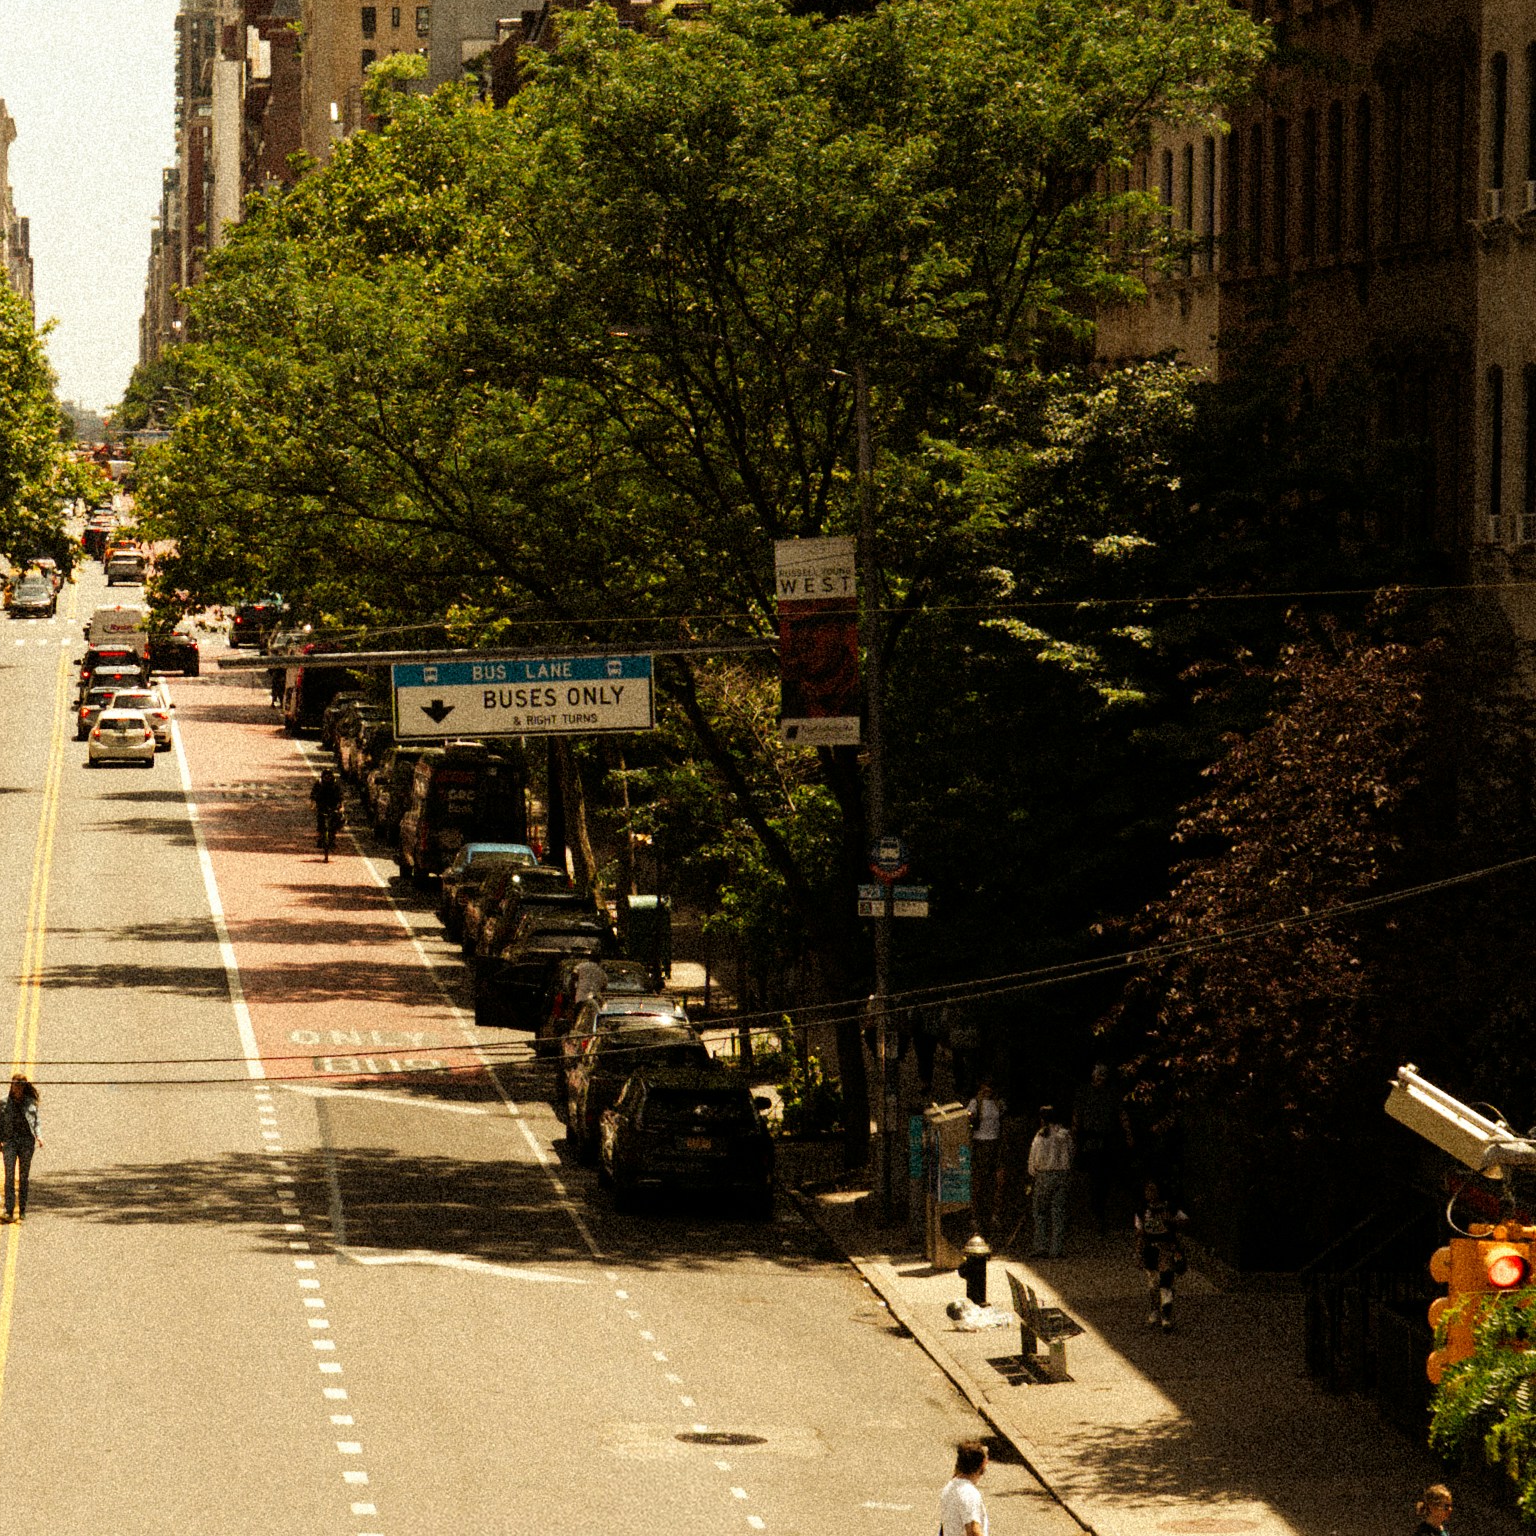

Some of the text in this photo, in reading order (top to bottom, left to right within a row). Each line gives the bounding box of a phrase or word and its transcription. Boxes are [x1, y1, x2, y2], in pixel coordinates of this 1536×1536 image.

[780, 576, 851, 594] WEST
[471, 662, 573, 681] BUS LANE
[483, 685, 625, 710] BUSES ONLY
[526, 713, 558, 726] RIGHT
[562, 712, 598, 725] TURNS
[289, 1028, 425, 1047] ONLY
